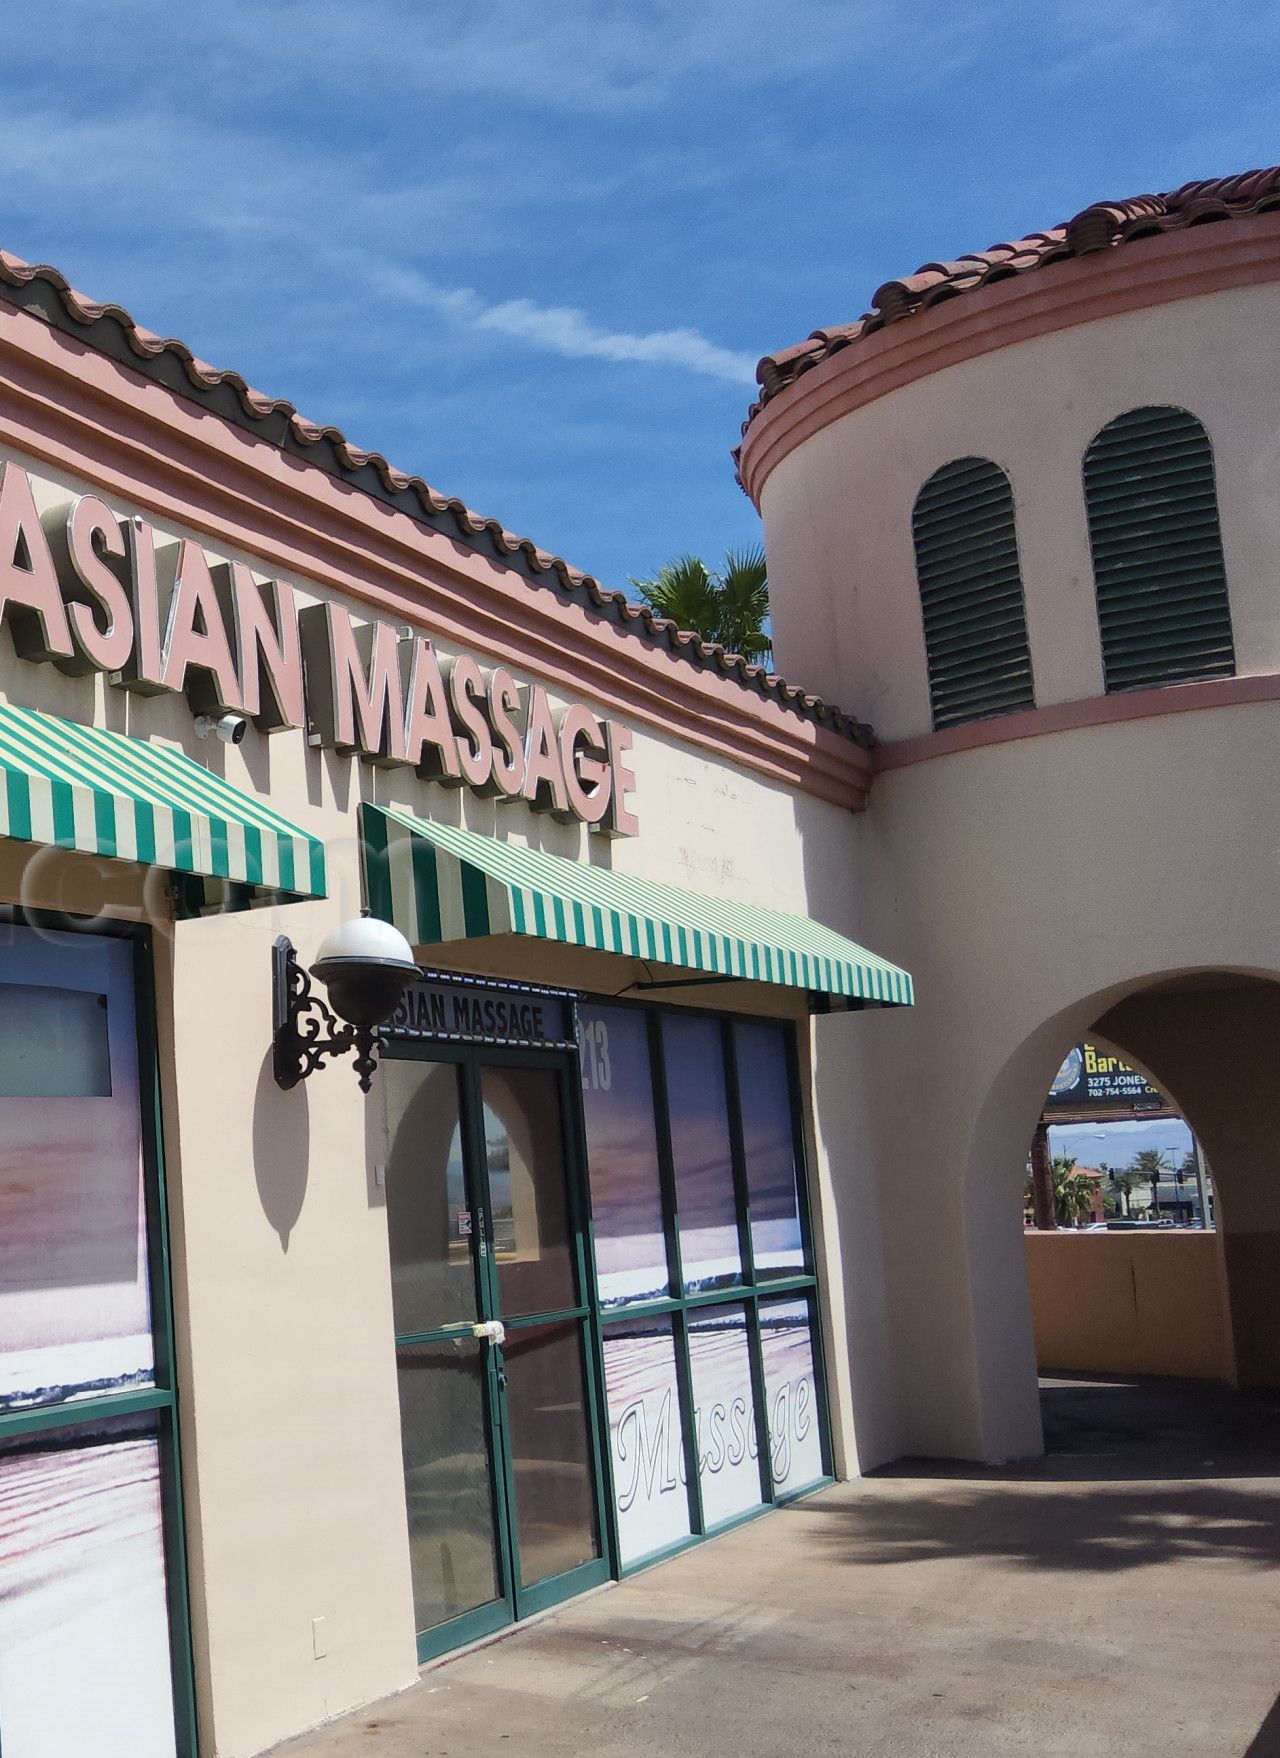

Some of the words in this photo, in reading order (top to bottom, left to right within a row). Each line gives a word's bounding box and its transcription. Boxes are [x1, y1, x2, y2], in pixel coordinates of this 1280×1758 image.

[324, 602, 640, 838] MASSAGE
[390, 990, 447, 1031] SIAN
[452, 996, 544, 1039] MASSAGE
[1087, 1077, 1110, 1087] 3275
[1113, 1075, 1147, 1086] JONES
[1088, 1086, 1141, 1096] 702-754-5564
